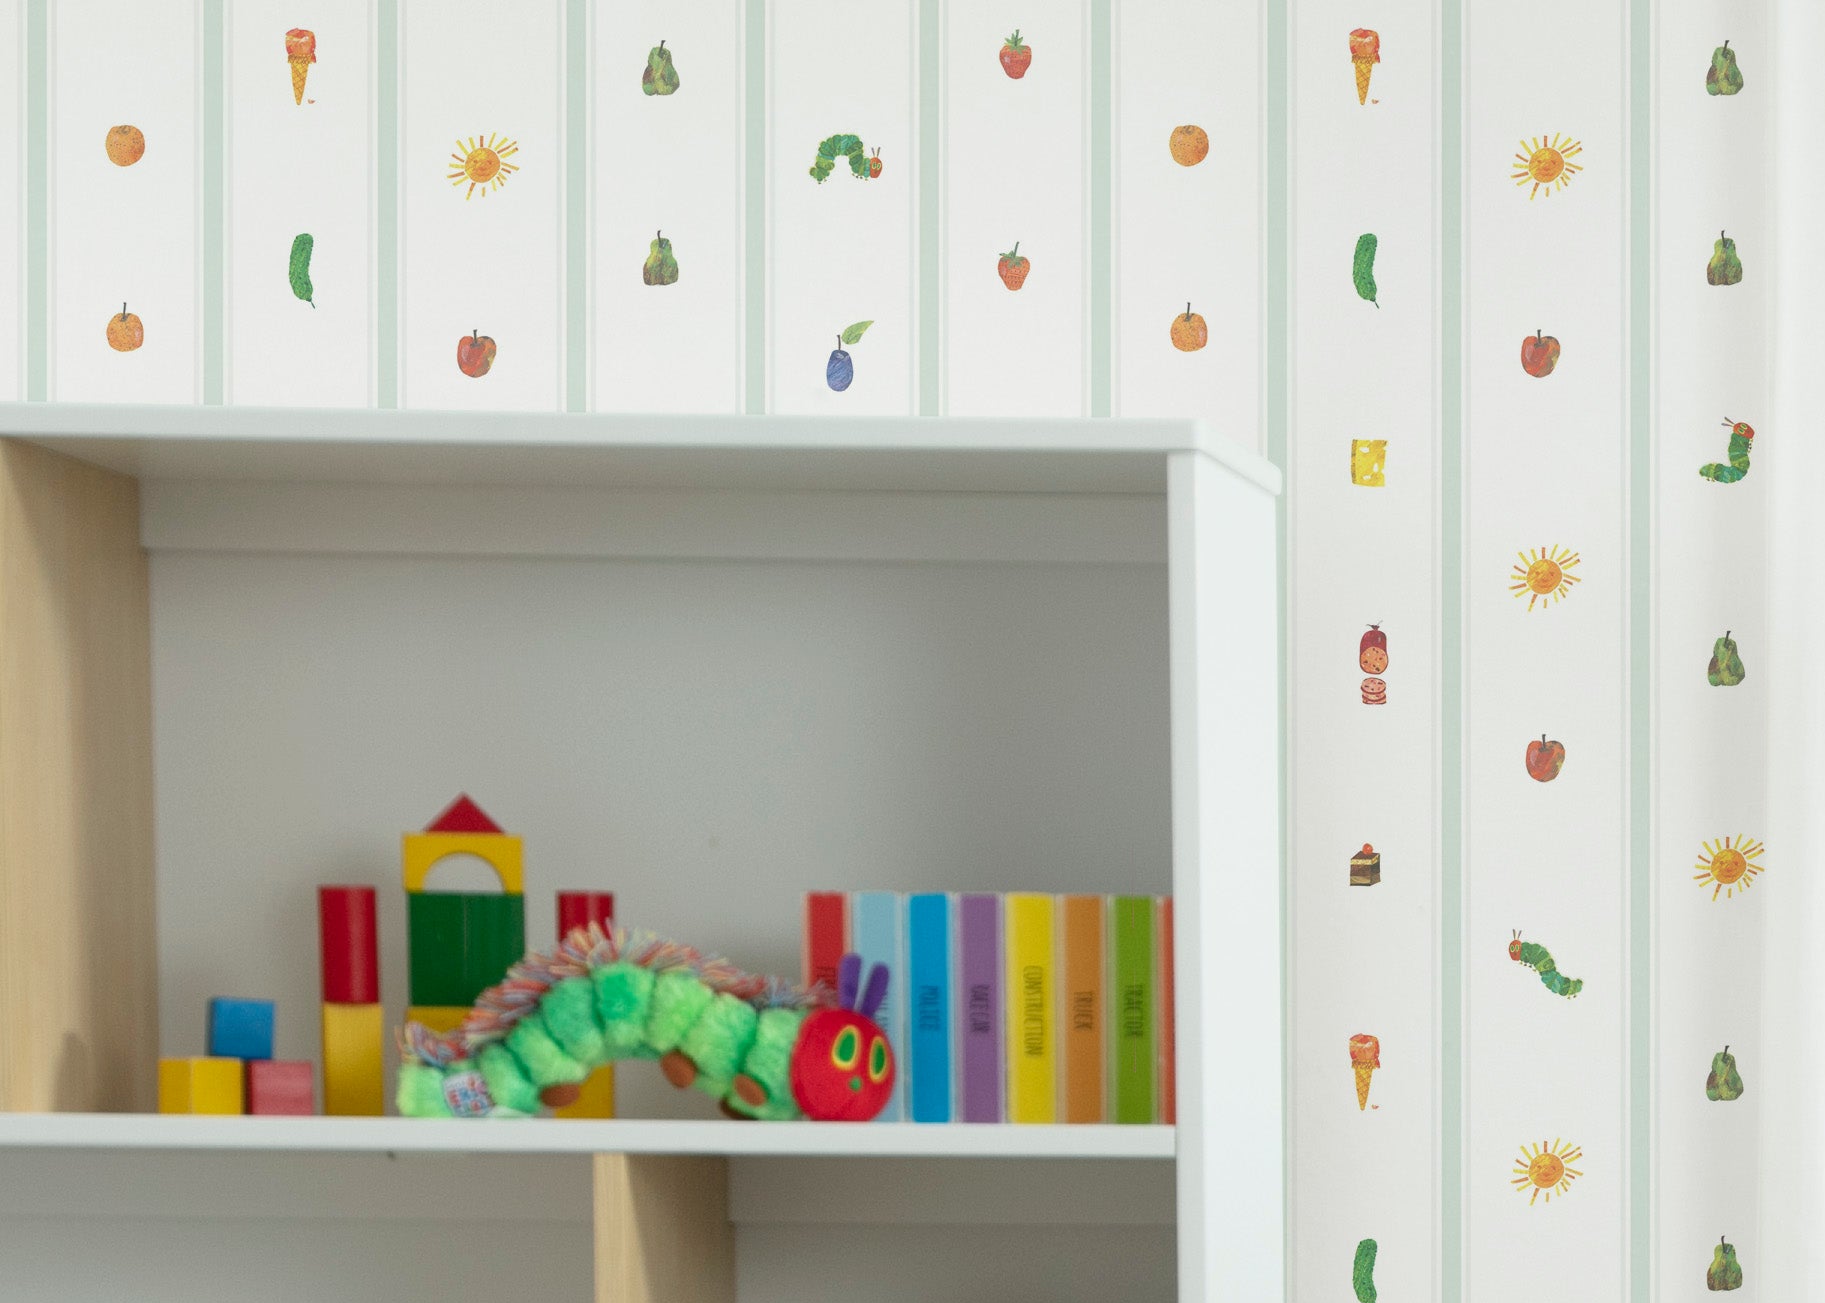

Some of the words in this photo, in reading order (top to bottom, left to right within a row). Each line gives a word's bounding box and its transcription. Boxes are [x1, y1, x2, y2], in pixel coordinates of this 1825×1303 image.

[1023, 965, 1045, 1057] CONSTRUCTION
[1073, 991, 1093, 1031] TRUCK
[1124, 984, 1144, 1038] TRACTOR
